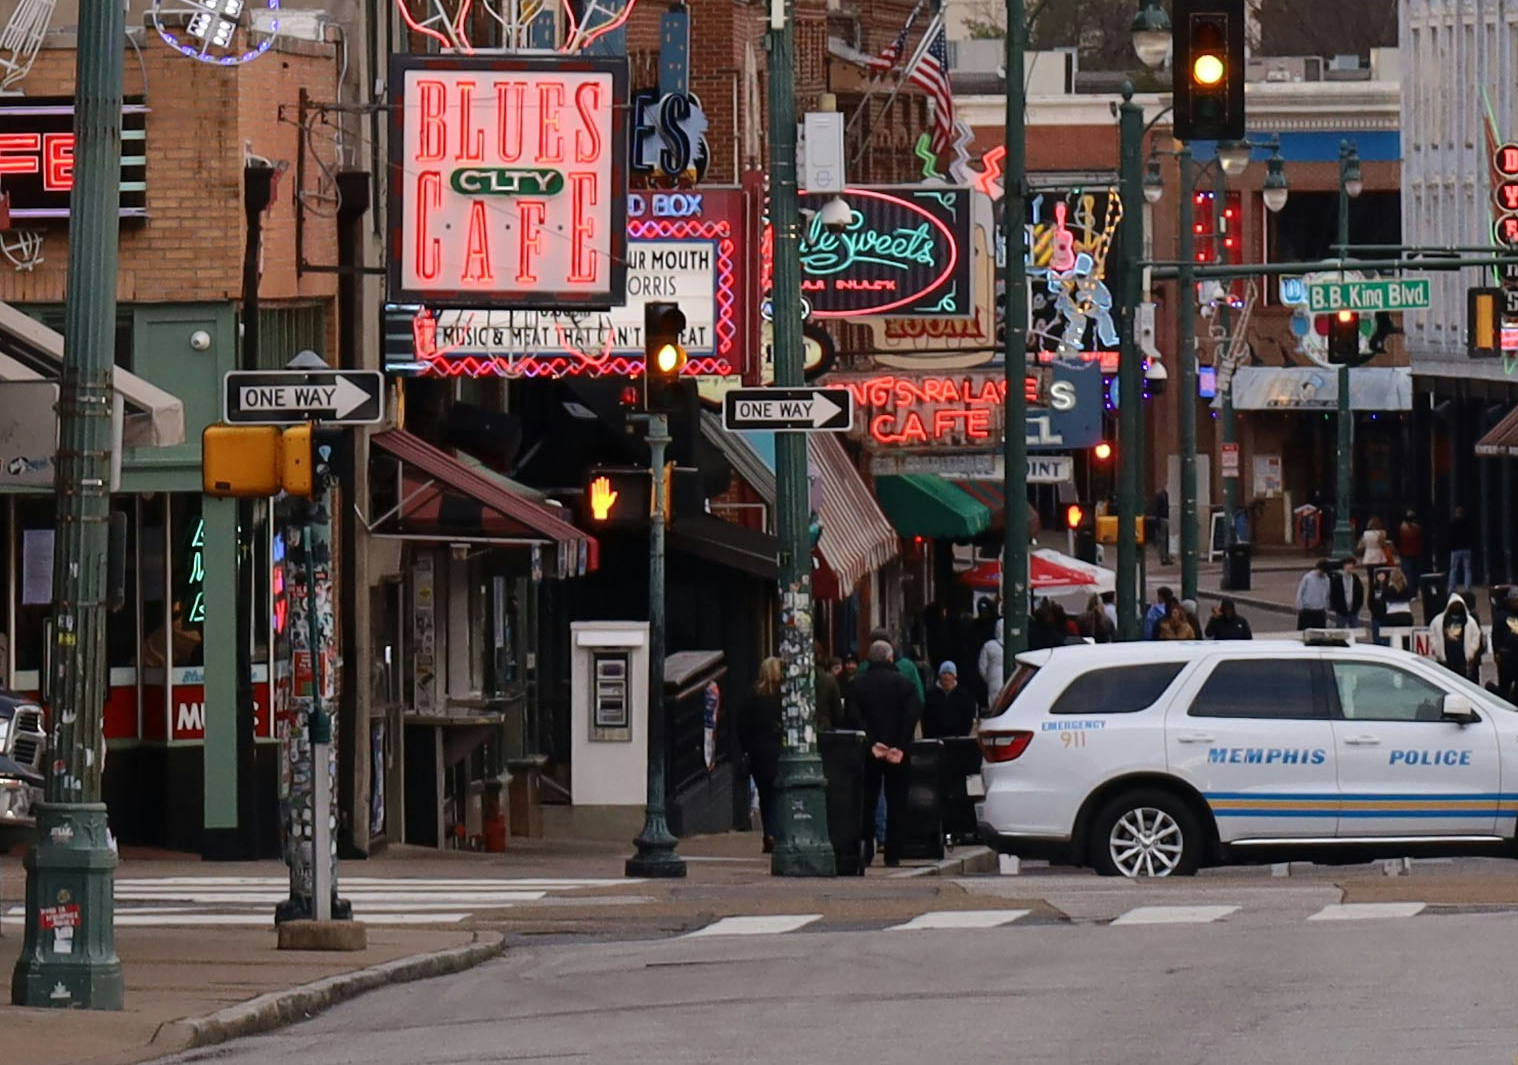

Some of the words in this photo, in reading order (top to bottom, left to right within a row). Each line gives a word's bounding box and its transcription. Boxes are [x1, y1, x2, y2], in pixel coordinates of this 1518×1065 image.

[415, 79, 602, 164] BLUES
[652, 194, 703, 217] BOX
[415, 169, 598, 284] CAFE
[806, 210, 935, 274] Sweets
[651, 249, 710, 271] MOUTH
[1311, 284, 1348, 309] B.B.
[1349, 283, 1383, 310] King
[1387, 283, 1429, 307] Blvd.
[442, 326, 490, 347] MUSIC
[492, 326, 504, 346] &
[511, 326, 549, 346] MEAT
[556, 326, 592, 346] THAT
[245, 388, 286, 407] ONE
[294, 388, 337, 407] WAY
[740, 402, 773, 418] ONE
[779, 402, 814, 418] WAY
[870, 409, 991, 444] CAFE
[1041, 719, 1107, 732] EMERGENCY
[1060, 731, 1087, 749] 911
[1207, 747, 1327, 766] MEMPHIS
[1388, 749, 1473, 766] POLICE
